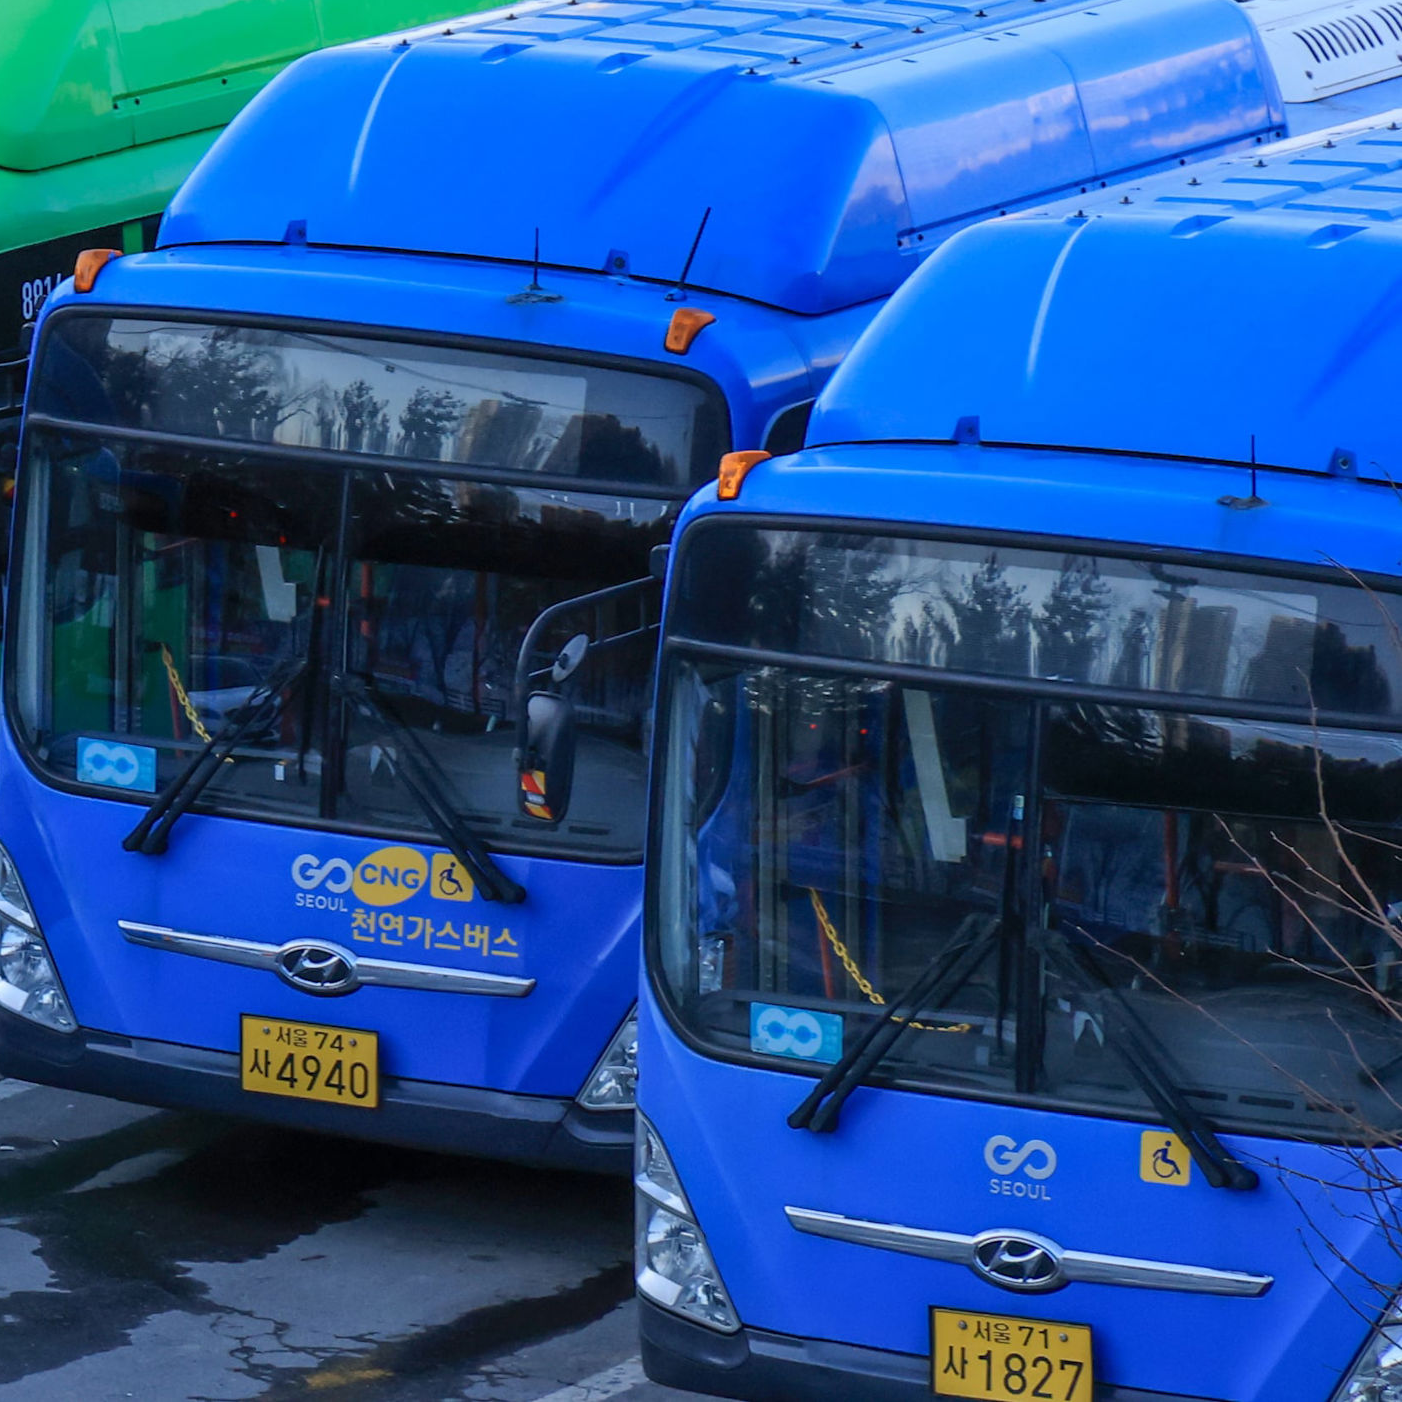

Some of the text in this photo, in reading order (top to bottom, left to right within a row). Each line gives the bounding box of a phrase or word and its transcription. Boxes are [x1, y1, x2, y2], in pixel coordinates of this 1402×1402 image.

[291, 853, 420, 894] GO CNG
[295, 893, 348, 912] SEOUL
[351, 908, 518, 957] 천연가스버스
[276, 1026, 344, 1052] 서울 74
[984, 1135, 1057, 1180] GO
[989, 1179, 1052, 1201] SEOUL
[973, 1320, 1049, 1349] 서울 71
[943, 1345, 1084, 1402] 사1827
